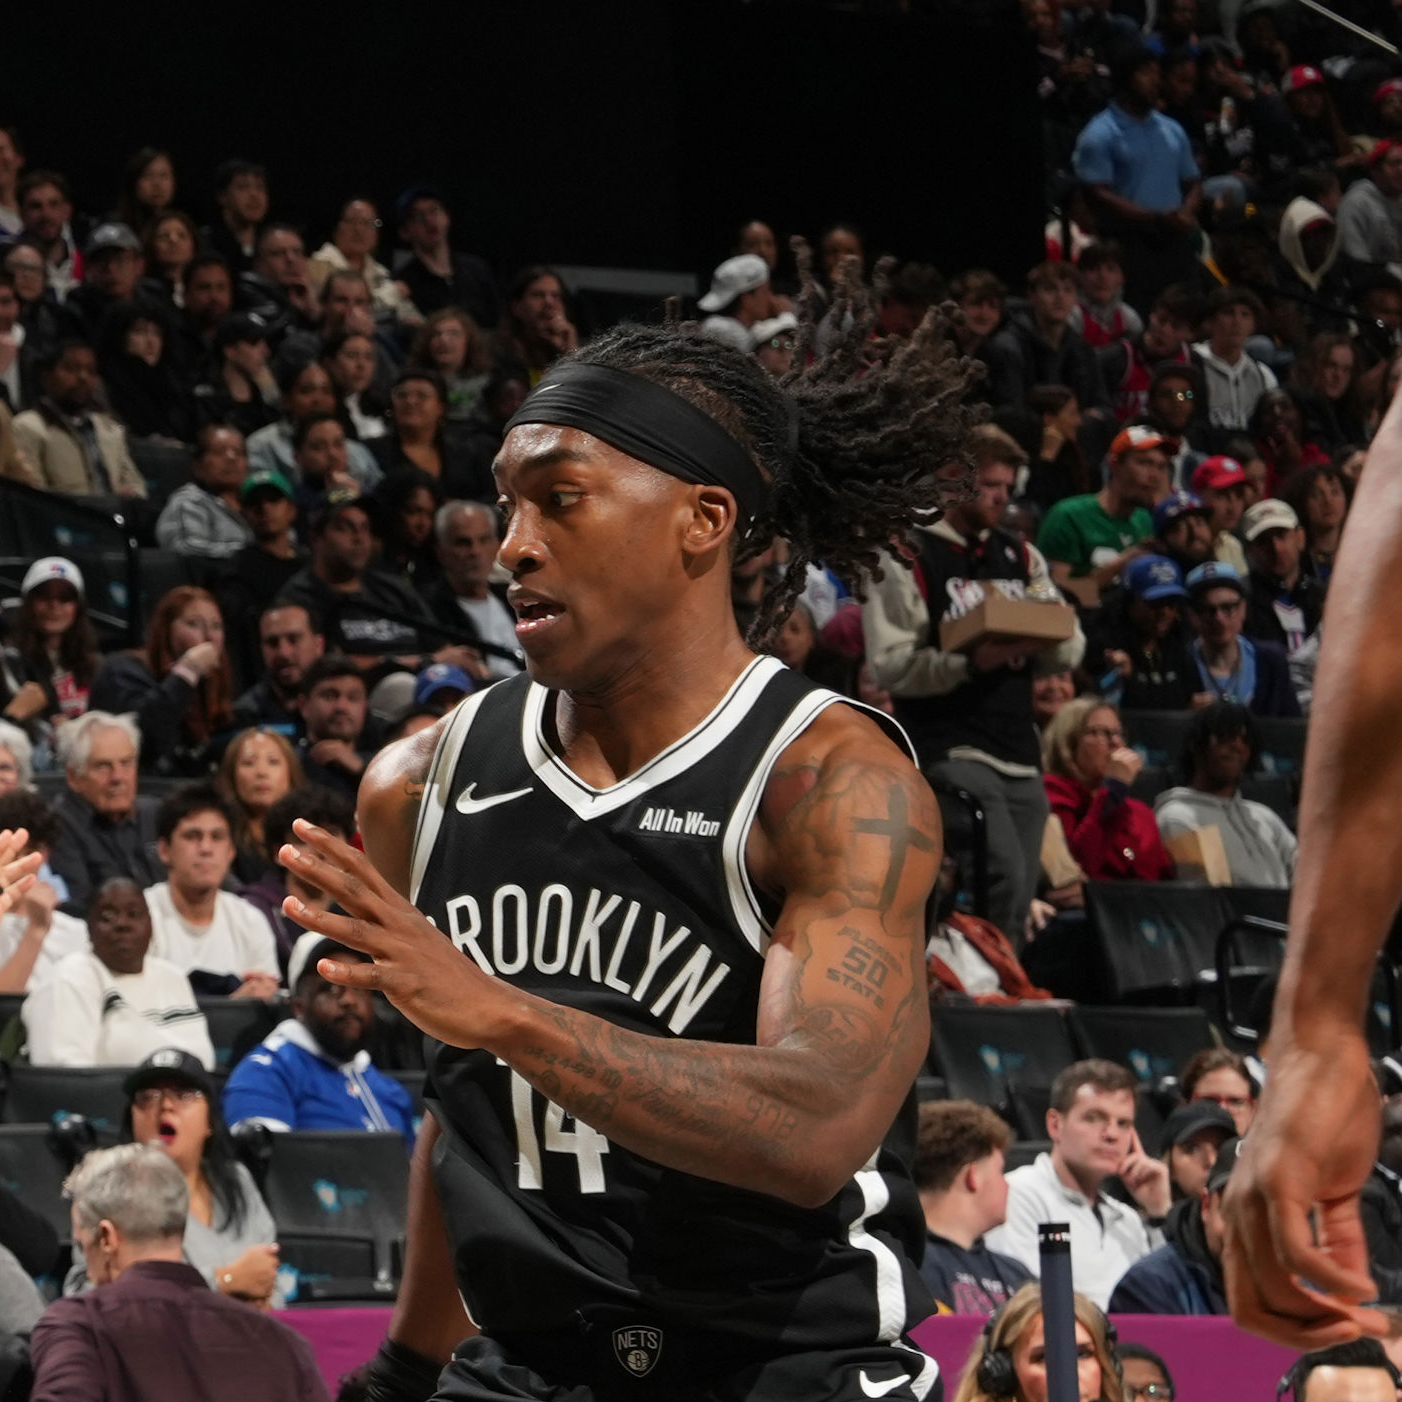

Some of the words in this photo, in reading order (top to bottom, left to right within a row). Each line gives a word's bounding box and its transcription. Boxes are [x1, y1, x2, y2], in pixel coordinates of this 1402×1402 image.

[639, 807, 666, 832] All
[664, 808, 683, 833] In
[684, 810, 721, 837] Won
[426, 884, 731, 1035] ROOKLYN
[496, 1056, 610, 1194] 14
[617, 1330, 658, 1351] NETS
